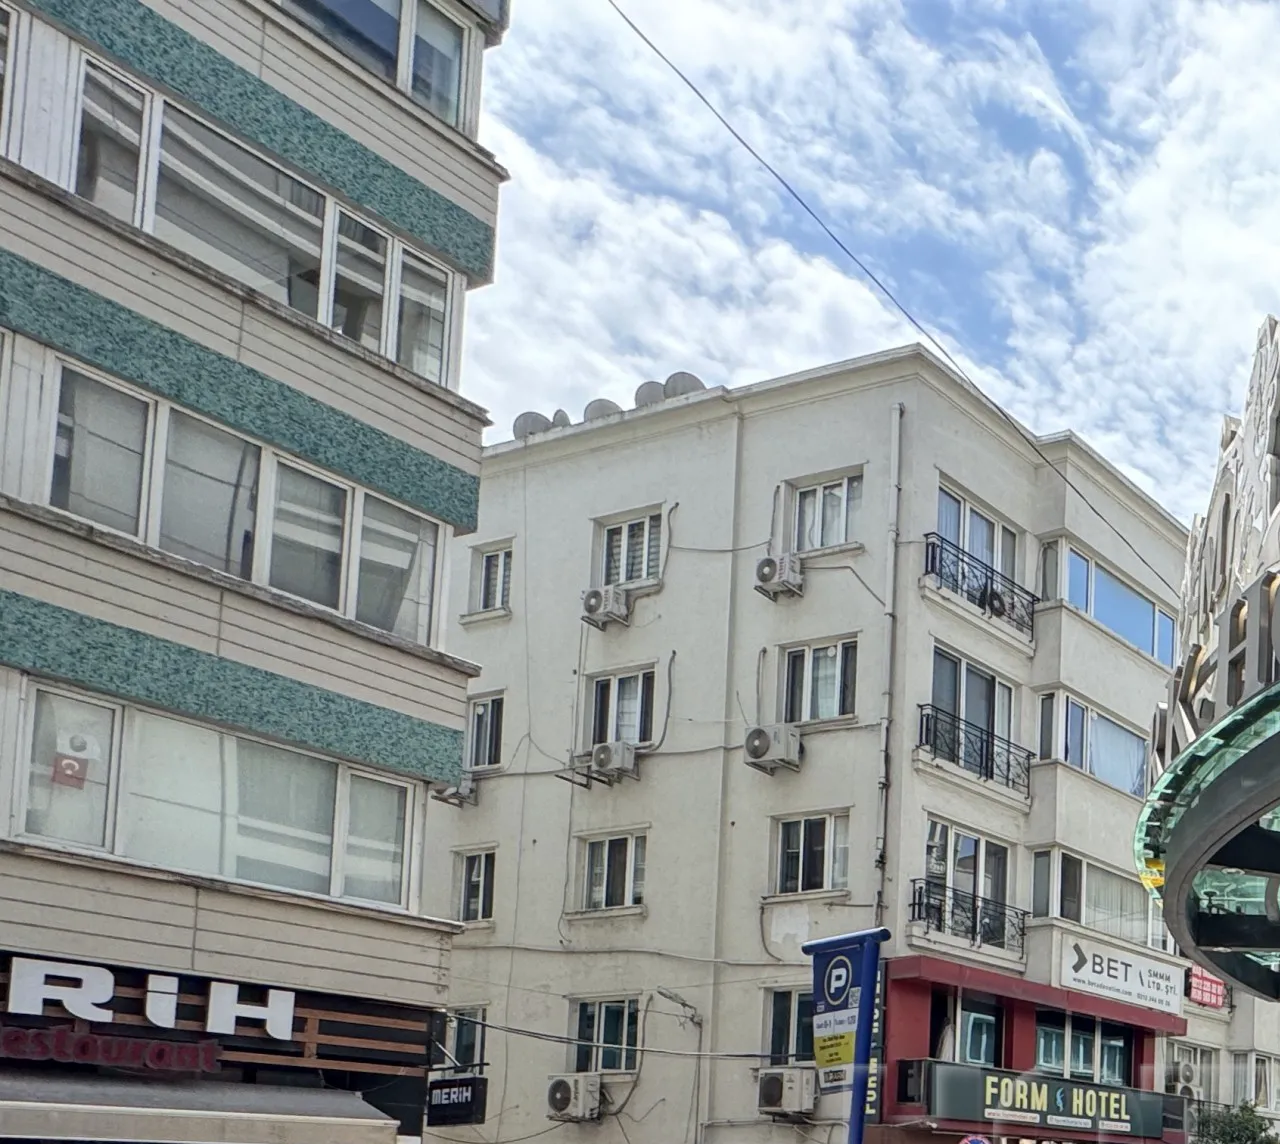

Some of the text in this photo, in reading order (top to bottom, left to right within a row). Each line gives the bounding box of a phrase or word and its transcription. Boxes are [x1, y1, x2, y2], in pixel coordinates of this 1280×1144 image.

[830, 967, 847, 994] P
[1092, 953, 1171, 983] BET SMMM
[985, 1075, 1131, 1121] FORM HOTEL
